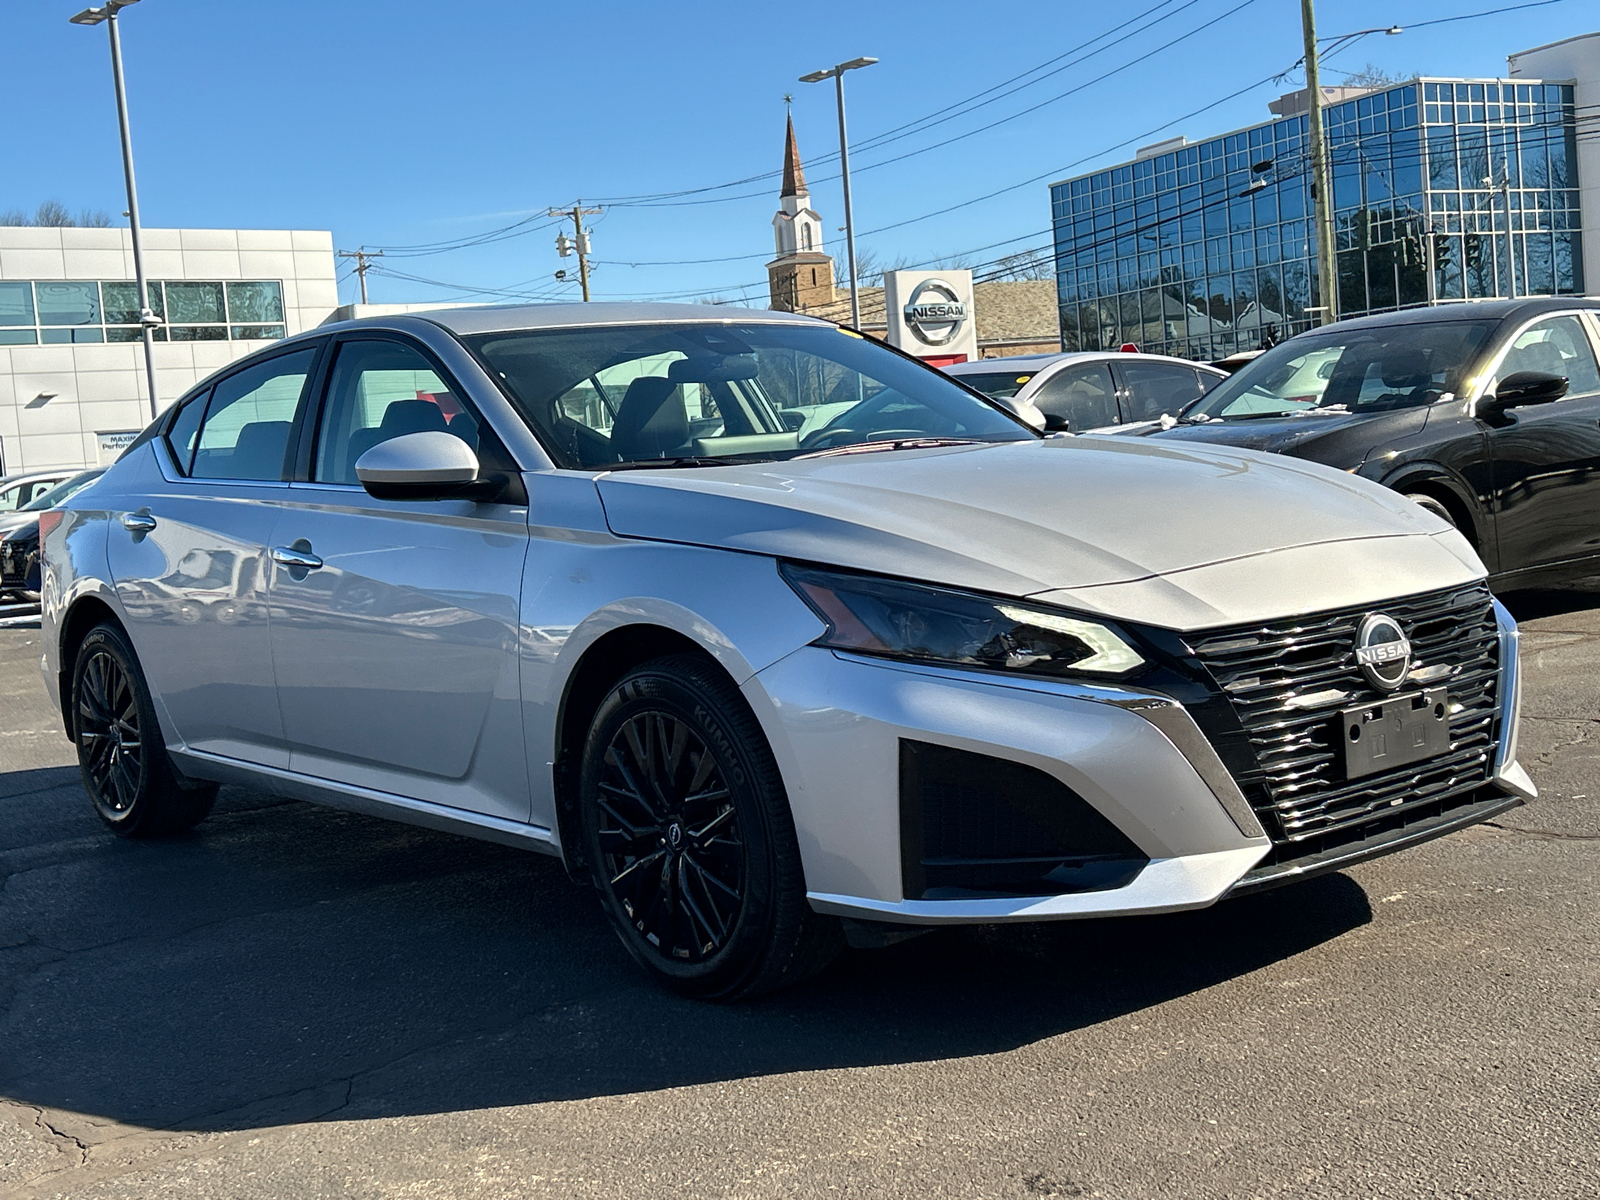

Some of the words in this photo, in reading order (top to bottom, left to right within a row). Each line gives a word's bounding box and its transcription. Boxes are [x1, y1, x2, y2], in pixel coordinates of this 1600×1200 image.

[912, 306, 964, 318] NISSAN
[1358, 642, 1411, 663] NISSAN
[694, 704, 745, 786] KUMHO
